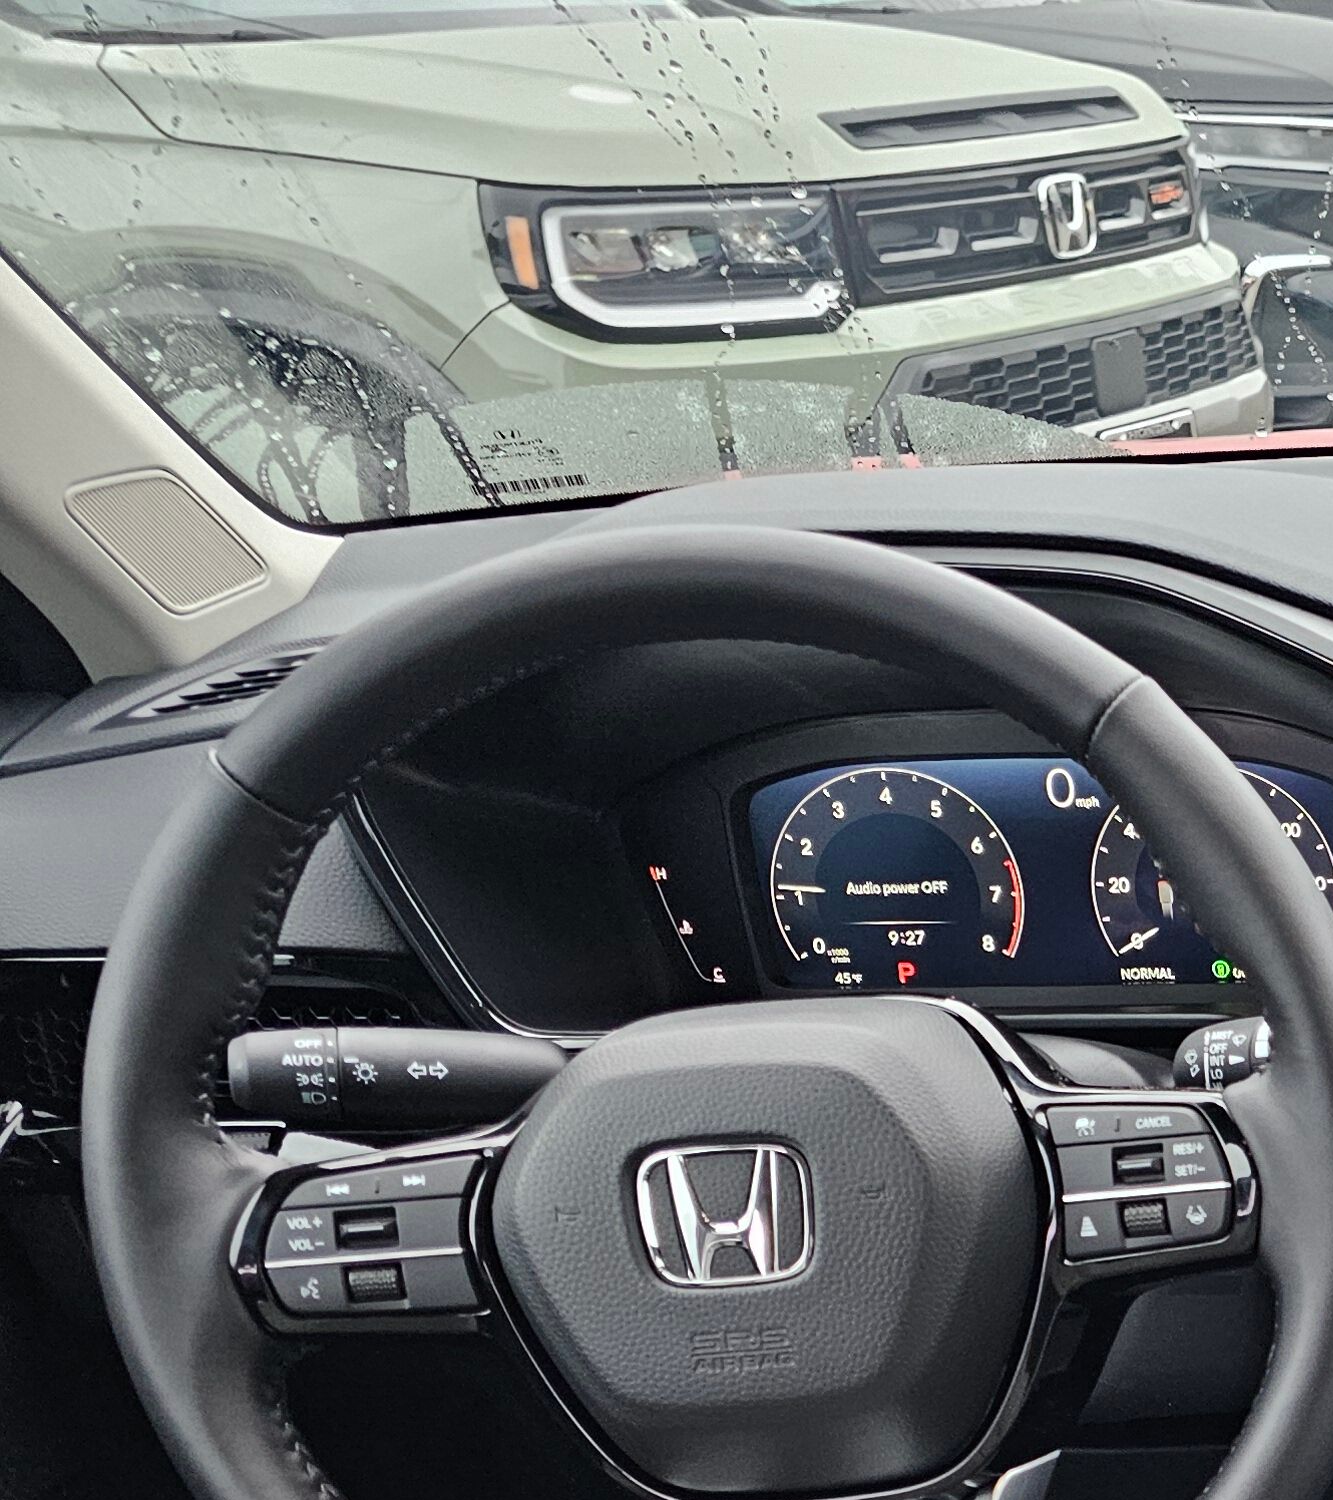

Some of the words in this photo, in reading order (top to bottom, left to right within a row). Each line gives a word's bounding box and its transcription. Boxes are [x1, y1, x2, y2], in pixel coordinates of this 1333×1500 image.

[879, 787, 893, 805] 4
[1046, 768, 1074, 809] 0
[1075, 795, 1100, 810] mph
[831, 800, 845, 819] 3
[930, 799, 942, 818] 5
[800, 837, 814, 856] 2
[970, 836, 984, 855] 6
[846, 881, 881, 895] Audio
[883, 883, 919, 896] power
[920, 880, 949, 894] OFF
[989, 885, 1002, 903] 7
[1108, 877, 1130, 895] 20
[812, 937, 826, 954] 0
[887, 930, 925, 947] 9:27
[982, 934, 995, 952] 8
[897, 961, 916, 984] P
[1120, 967, 1176, 982] NORMAL
[294, 1039, 322, 1049] OFF
[1211, 1030, 1234, 1042] MIST
[1210, 1043, 1228, 1055] OFF
[281, 1054, 323, 1067] AUTO
[1210, 1056, 1226, 1067] INT
[1135, 1115, 1173, 1130] CANCEL
